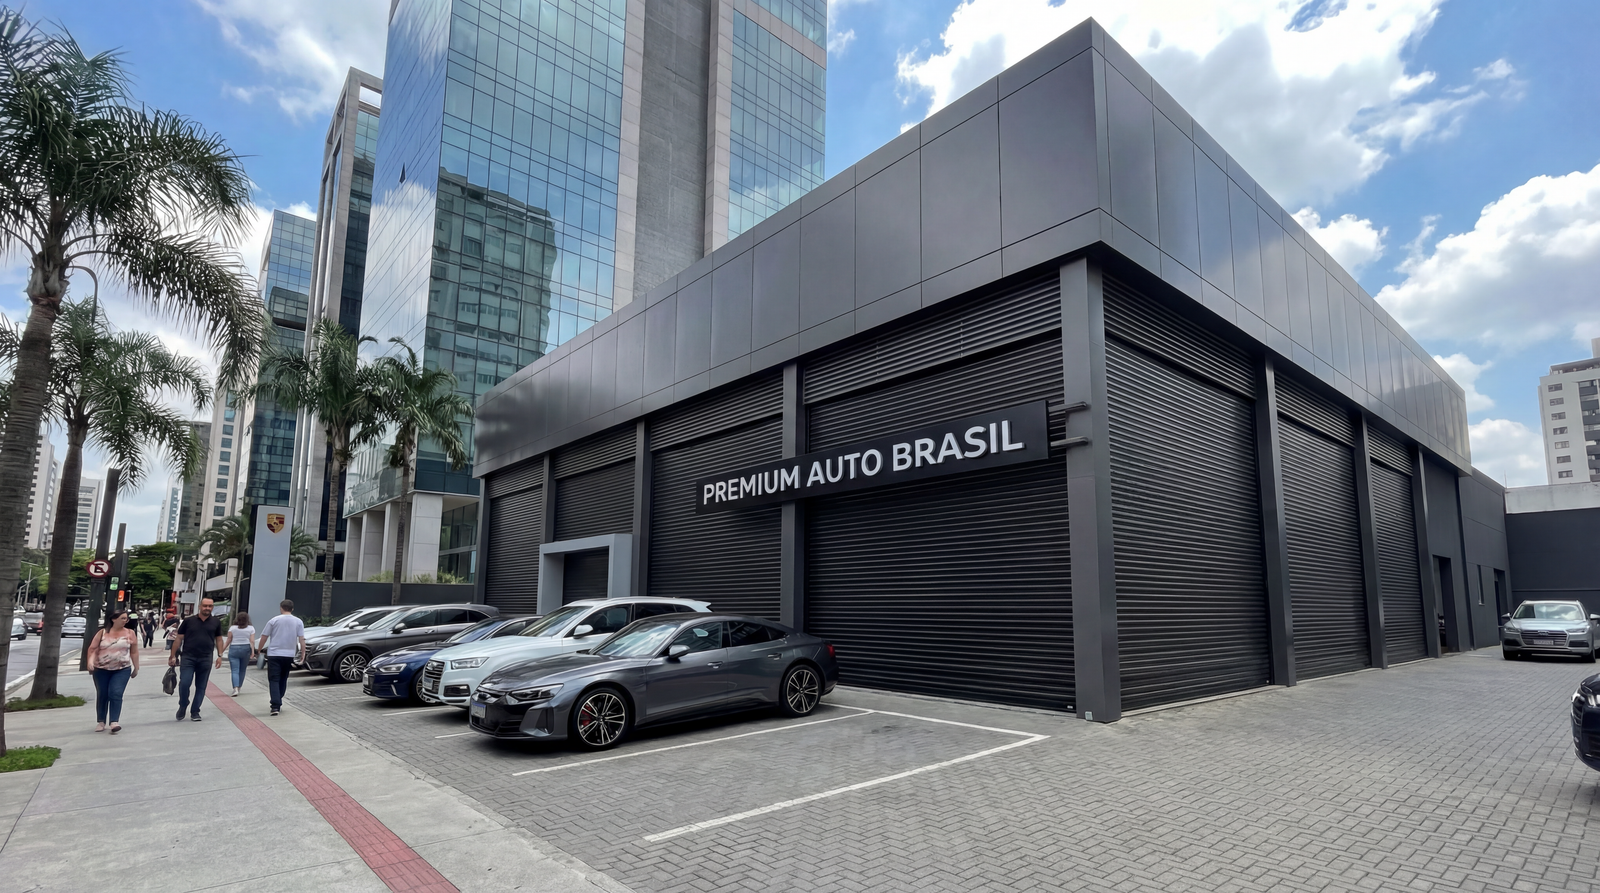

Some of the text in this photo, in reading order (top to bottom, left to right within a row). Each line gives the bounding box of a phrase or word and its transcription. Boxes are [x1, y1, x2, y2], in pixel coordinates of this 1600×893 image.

[703, 419, 1024, 505] PREMIUM AUTO BRASIL
